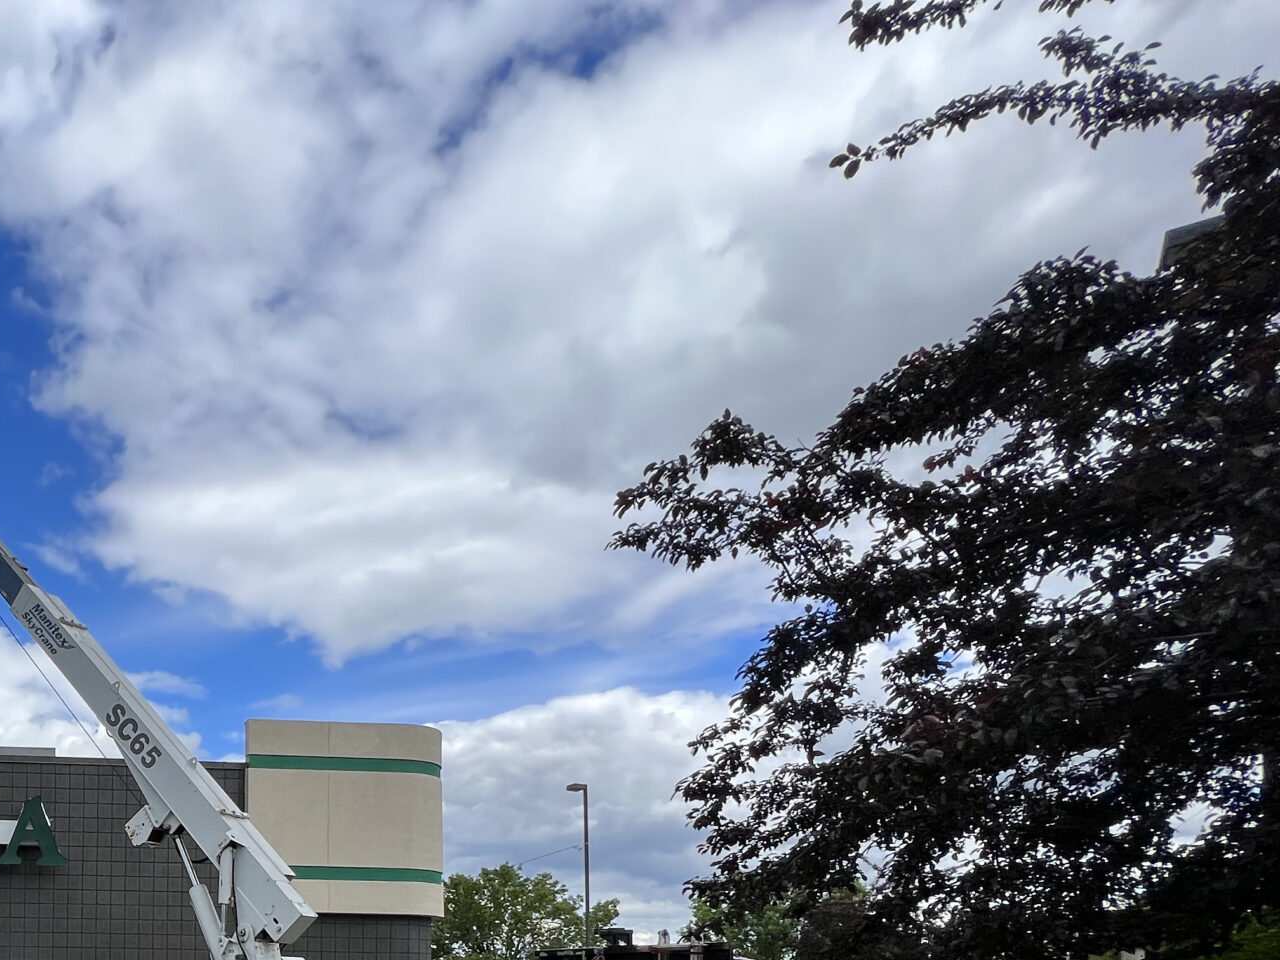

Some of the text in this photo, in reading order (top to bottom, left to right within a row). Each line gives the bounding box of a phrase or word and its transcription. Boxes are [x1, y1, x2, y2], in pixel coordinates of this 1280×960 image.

[21, 611, 58, 655] SkyCrane
[31, 603, 70, 648] Manitex
[105, 703, 163, 769] SC65
